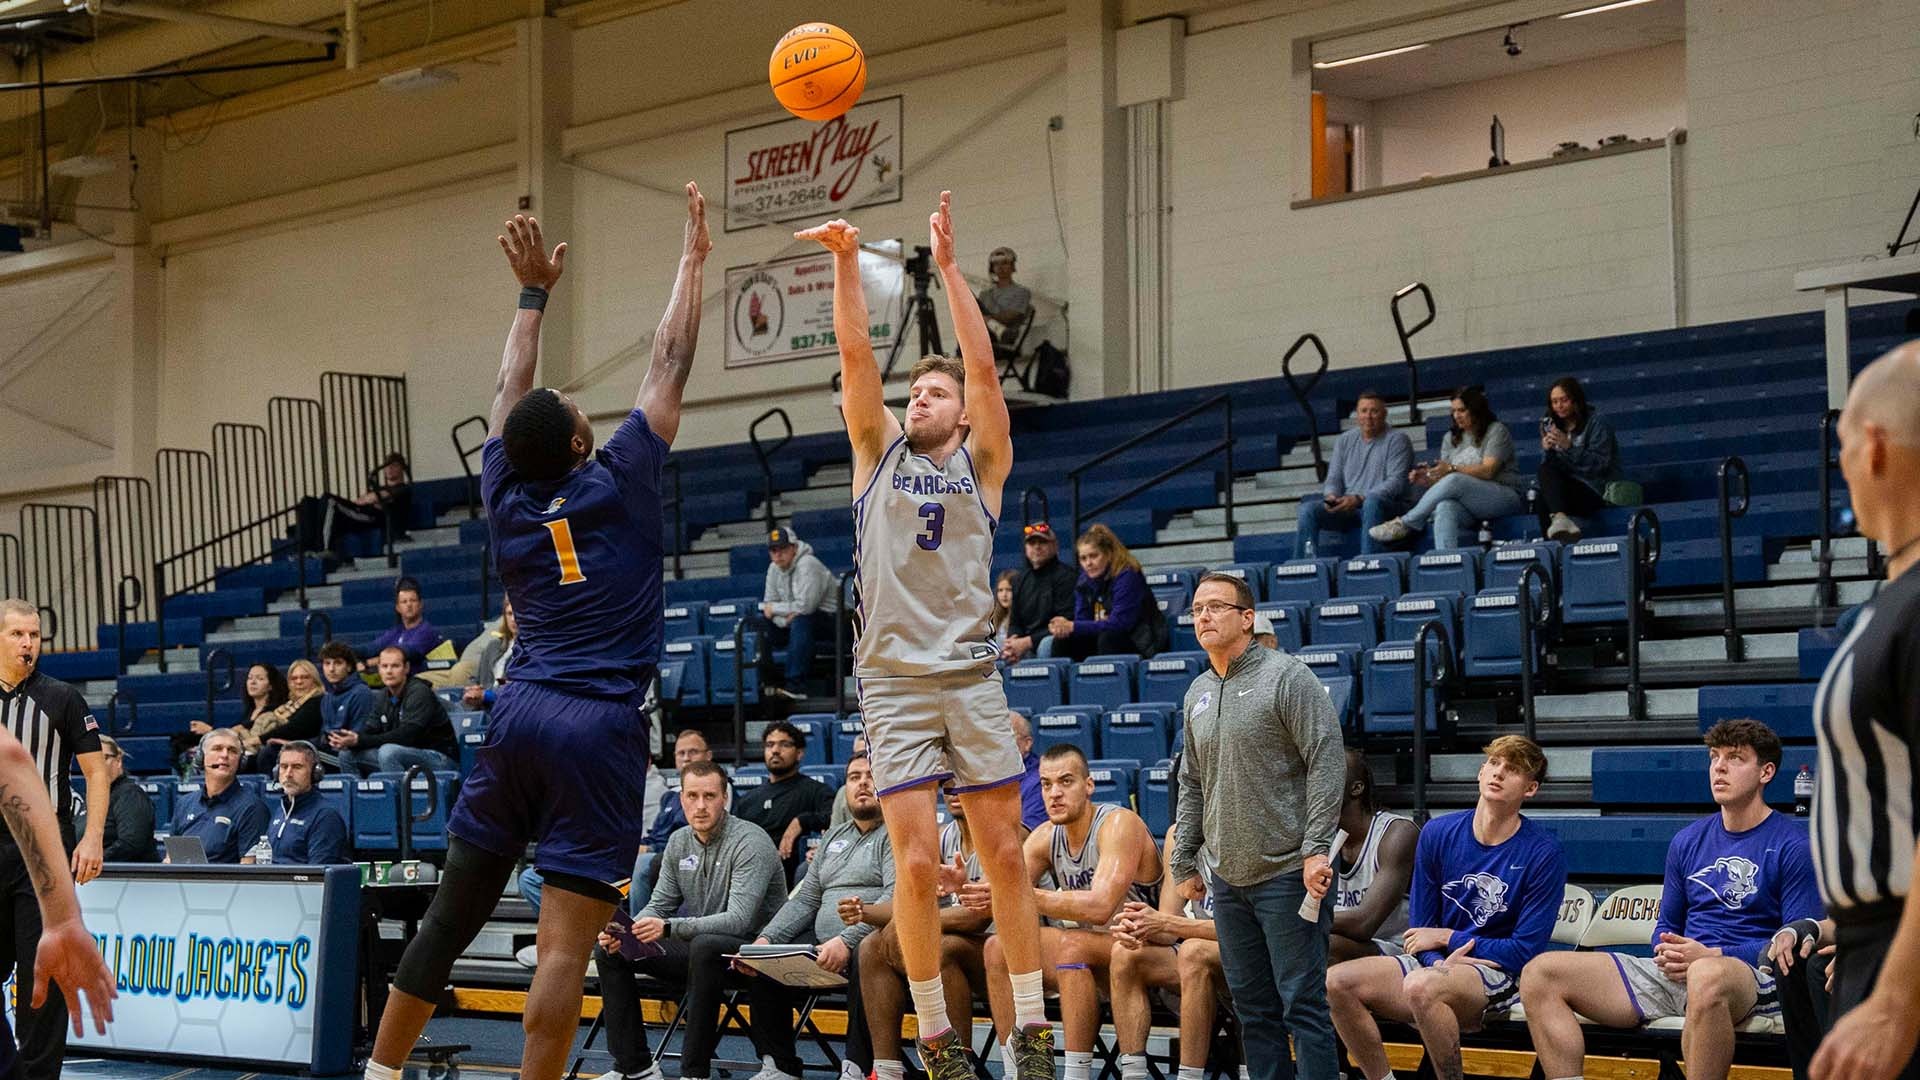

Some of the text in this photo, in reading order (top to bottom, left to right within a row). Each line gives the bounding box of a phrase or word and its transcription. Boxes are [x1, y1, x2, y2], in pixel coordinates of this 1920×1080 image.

[916, 502, 945, 551] 3
[542, 518, 587, 585] 1
[1573, 544, 1618, 555] RESERVED
[1420, 555, 1461, 565] RESERVED
[1496, 550, 1536, 561] RESERVED
[1277, 564, 1317, 575] RESERVED
[1396, 601, 1435, 611] RESERVED
[1475, 596, 1516, 607] RESERVED
[1320, 605, 1359, 616] RESERVED
[1374, 650, 1415, 661] RESERVED
[1149, 660, 1185, 671] RESERVED
[1011, 666, 1049, 677] RESERVED
[1602, 896, 1662, 921] JACK
[177, 933, 310, 1010] JACKETS
